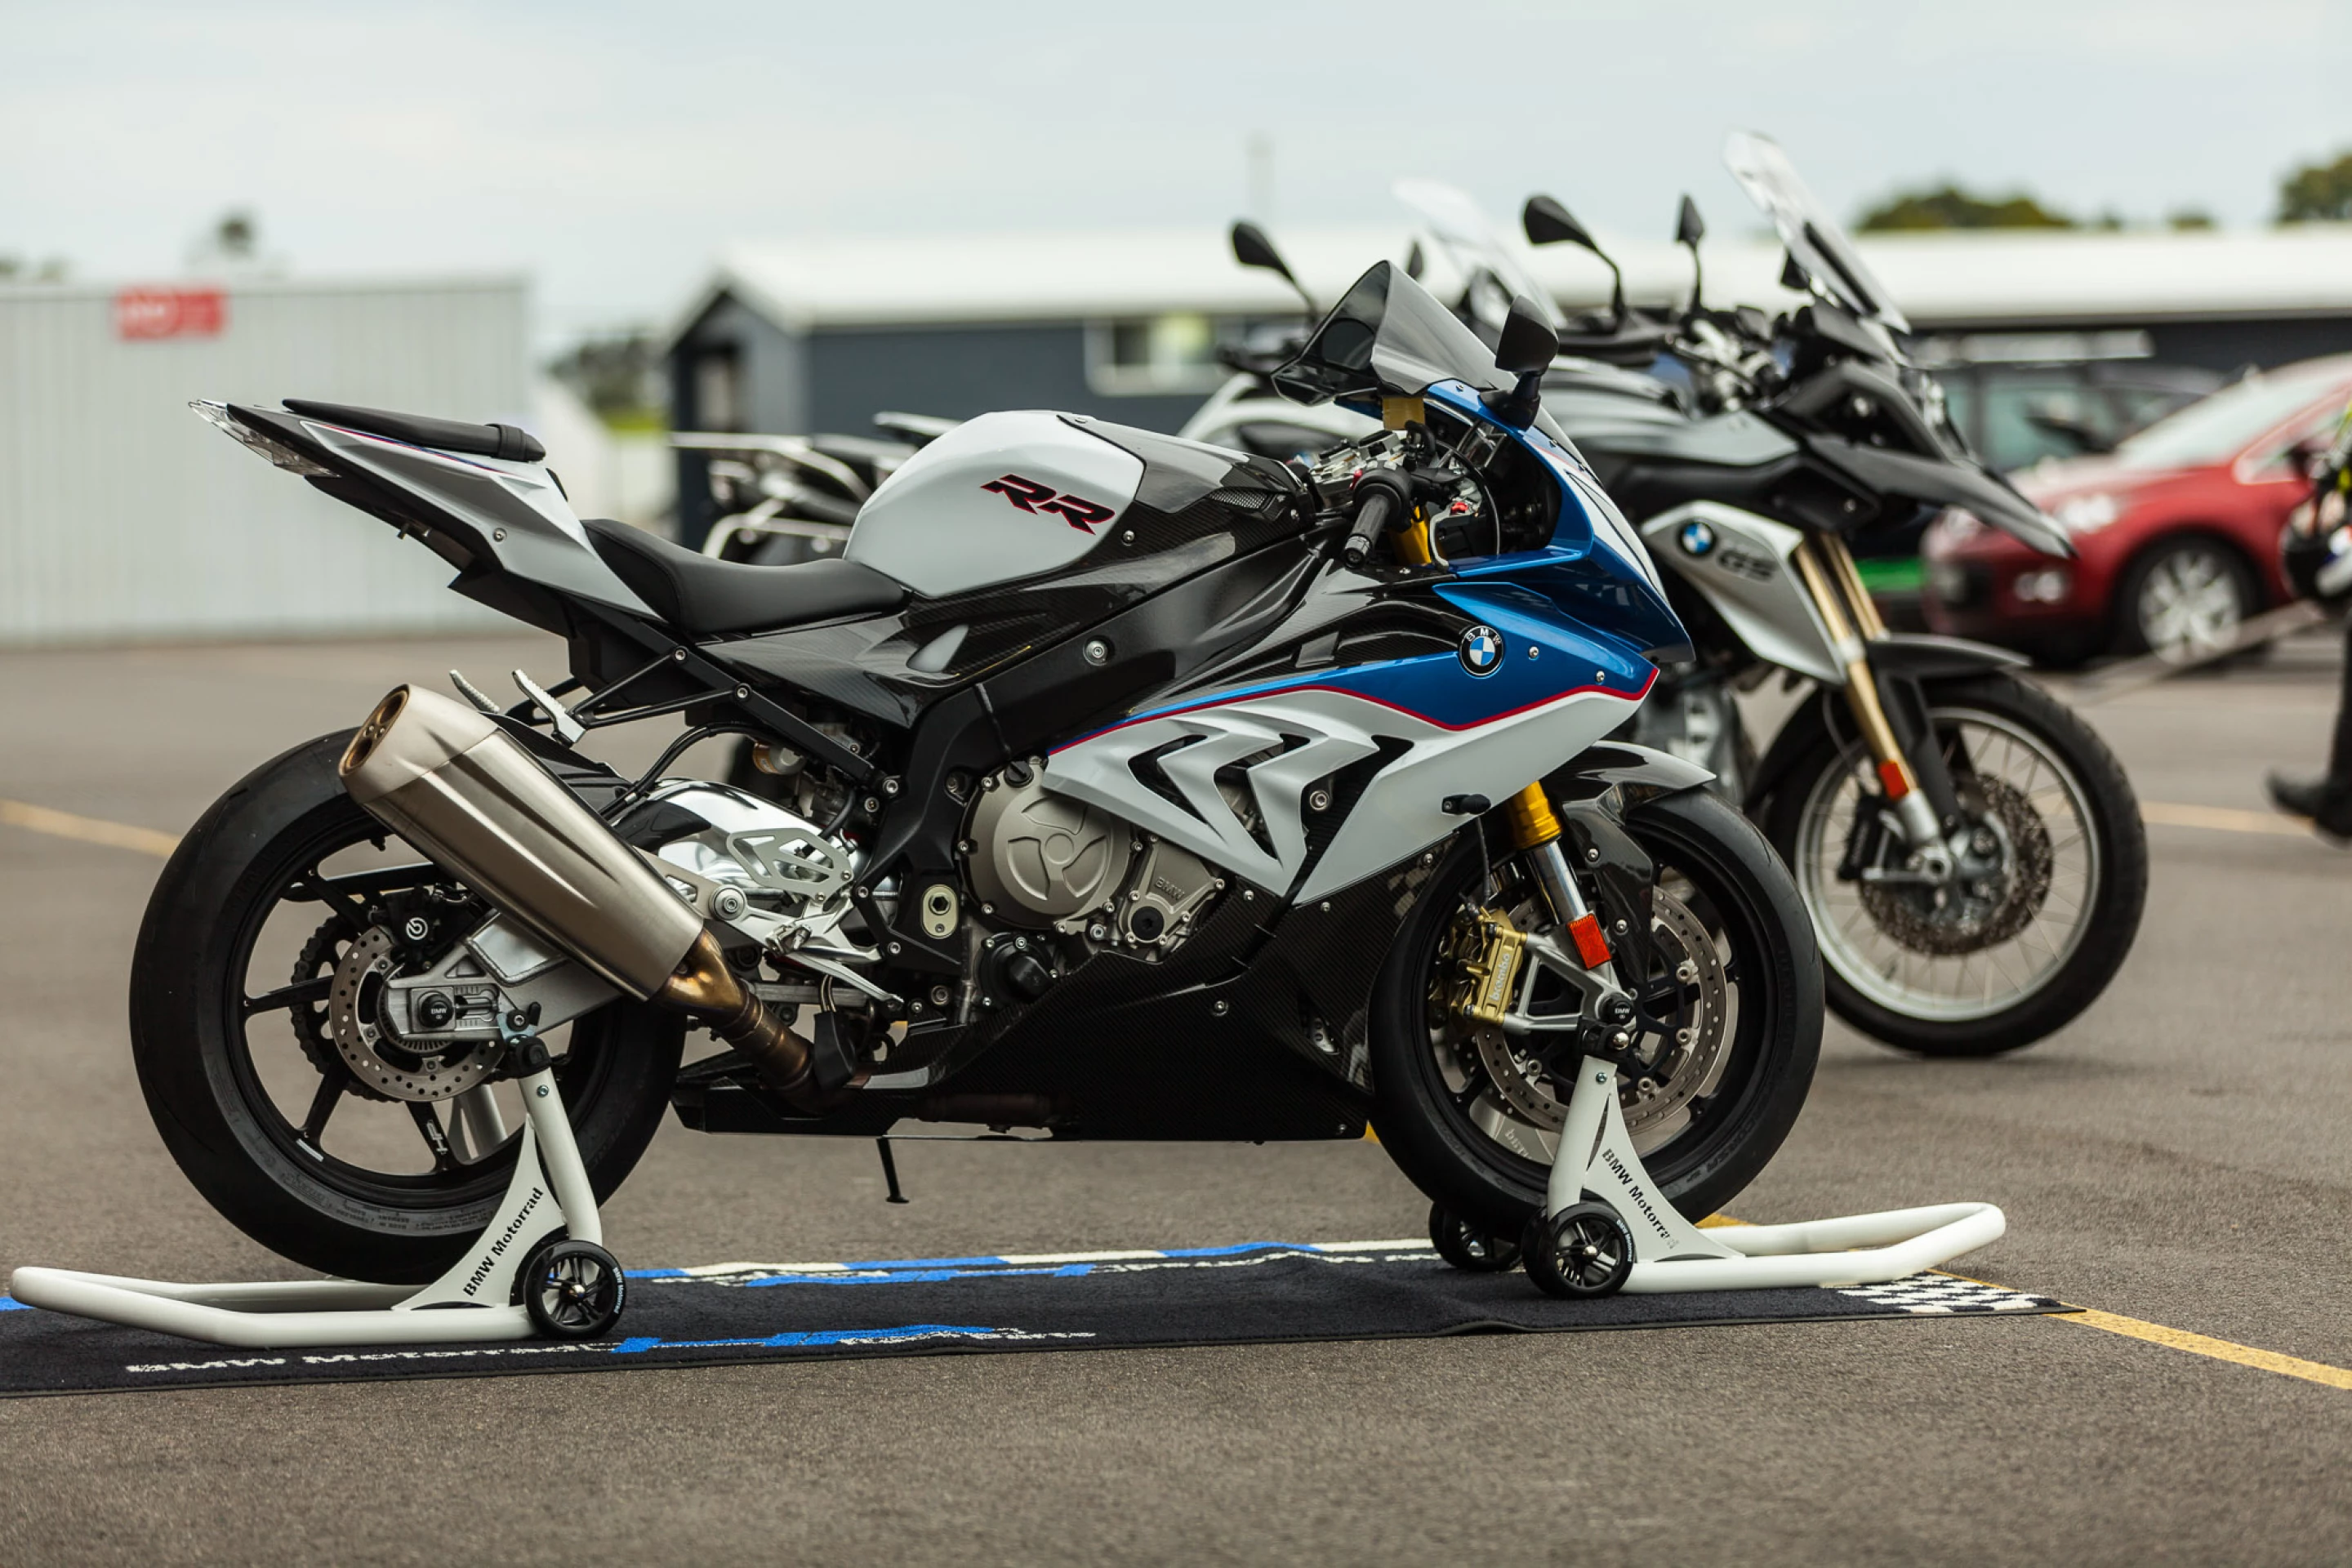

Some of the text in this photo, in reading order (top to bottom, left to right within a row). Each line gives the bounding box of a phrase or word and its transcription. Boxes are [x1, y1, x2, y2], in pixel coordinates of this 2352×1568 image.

[980, 473, 1116, 536] RR
[1466, 627, 1502, 645] BMW
[1156, 876, 1185, 899] BMW
[1489, 953, 1510, 1000] brembo
[1601, 1148, 1680, 1250] BMW Motorrad
[462, 1186, 544, 1297] BMW Motorrad
